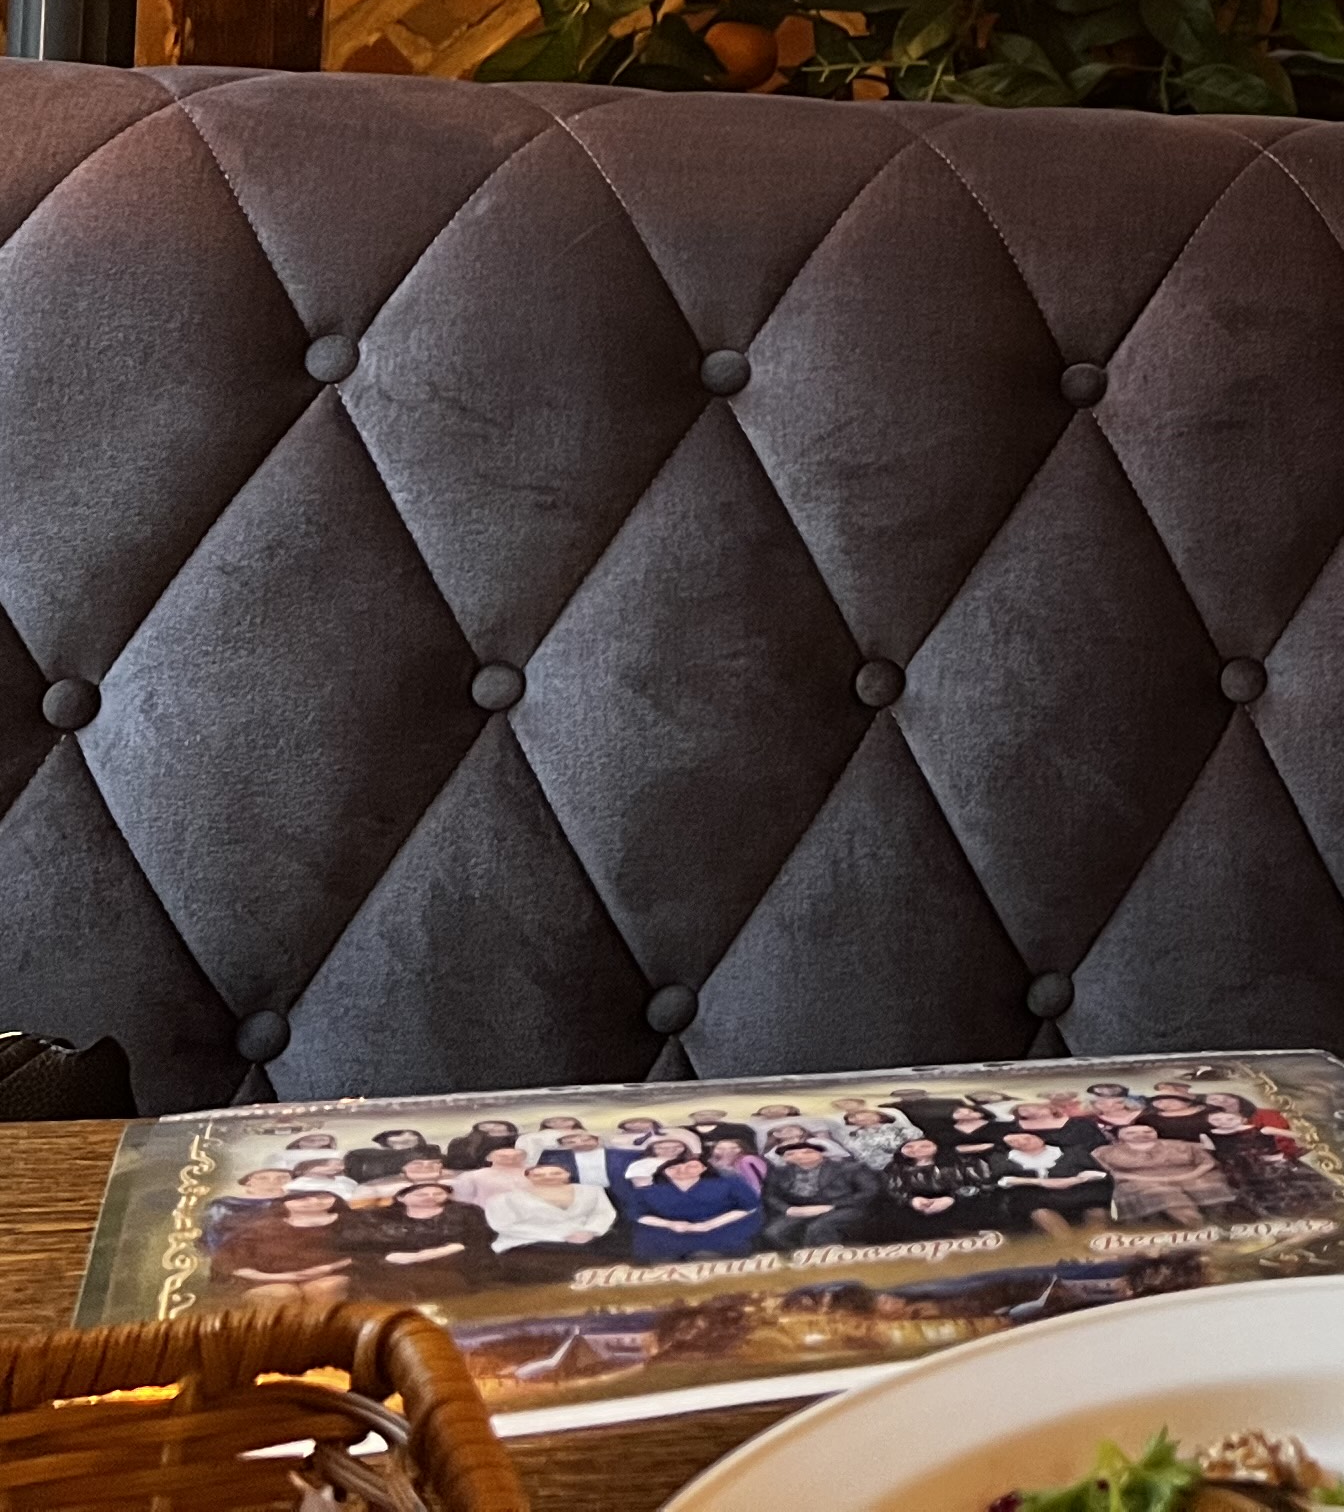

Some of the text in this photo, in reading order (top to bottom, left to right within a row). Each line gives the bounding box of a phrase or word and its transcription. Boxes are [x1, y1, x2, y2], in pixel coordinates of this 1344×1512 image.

[573, 1231, 1003, 1287] Нижний Новгород
[1090, 1227, 1219, 1251] Весна
